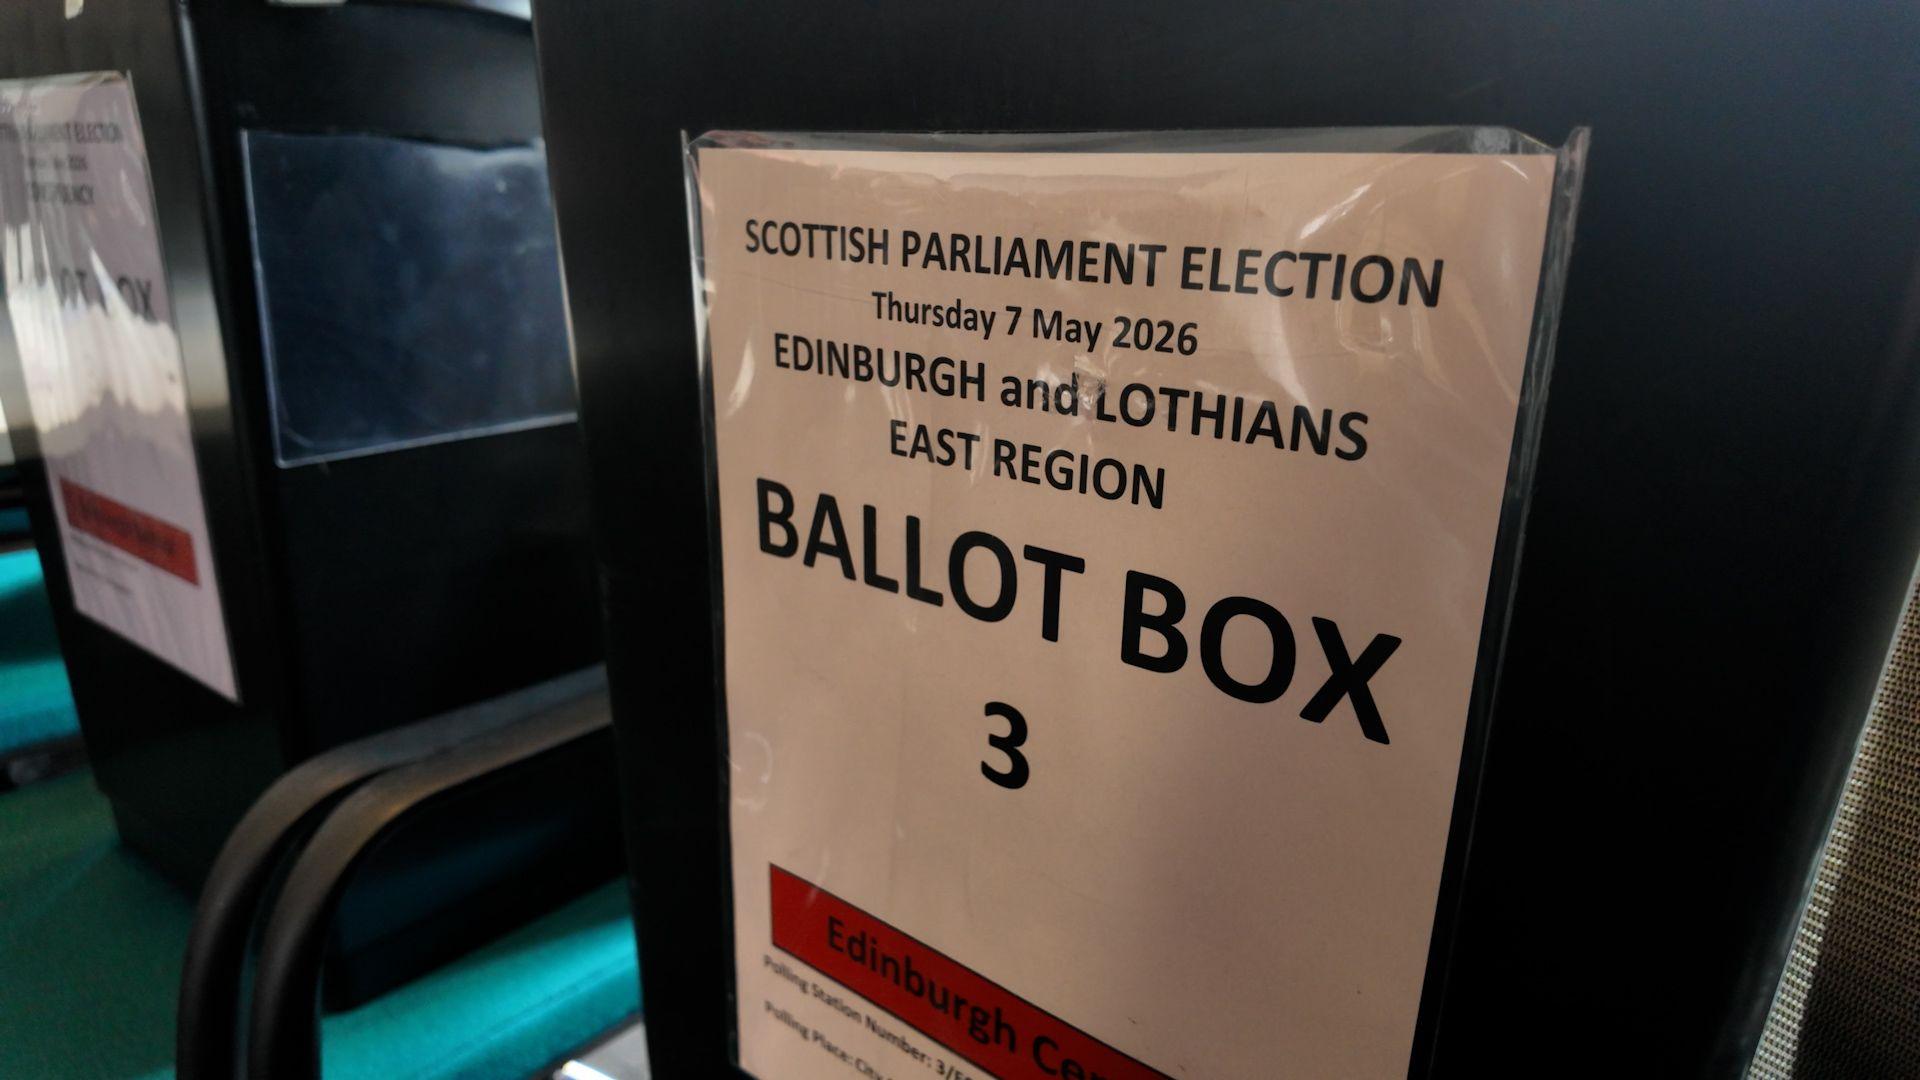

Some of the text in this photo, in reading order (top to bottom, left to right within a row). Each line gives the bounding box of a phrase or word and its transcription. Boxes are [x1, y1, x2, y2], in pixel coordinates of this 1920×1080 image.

[745, 219, 1444, 308] SCOTTISH PARLIAMENT ELECTION
[871, 291, 1198, 356] Thursday 7 May 2026
[774, 332, 1368, 461] EDINBURGH and LOTHIANS
[890, 419, 1166, 509] EAST REGION
[756, 478, 1403, 745] BALLOT BOX
[980, 701, 1030, 790] 3
[764, 953, 809, 995] Polling
[812, 983, 863, 1024] Station
[864, 1014, 932, 1069] Number:
[764, 1000, 810, 1042] Polling
[827, 915, 1108, 1080] Edinburgh Ce
